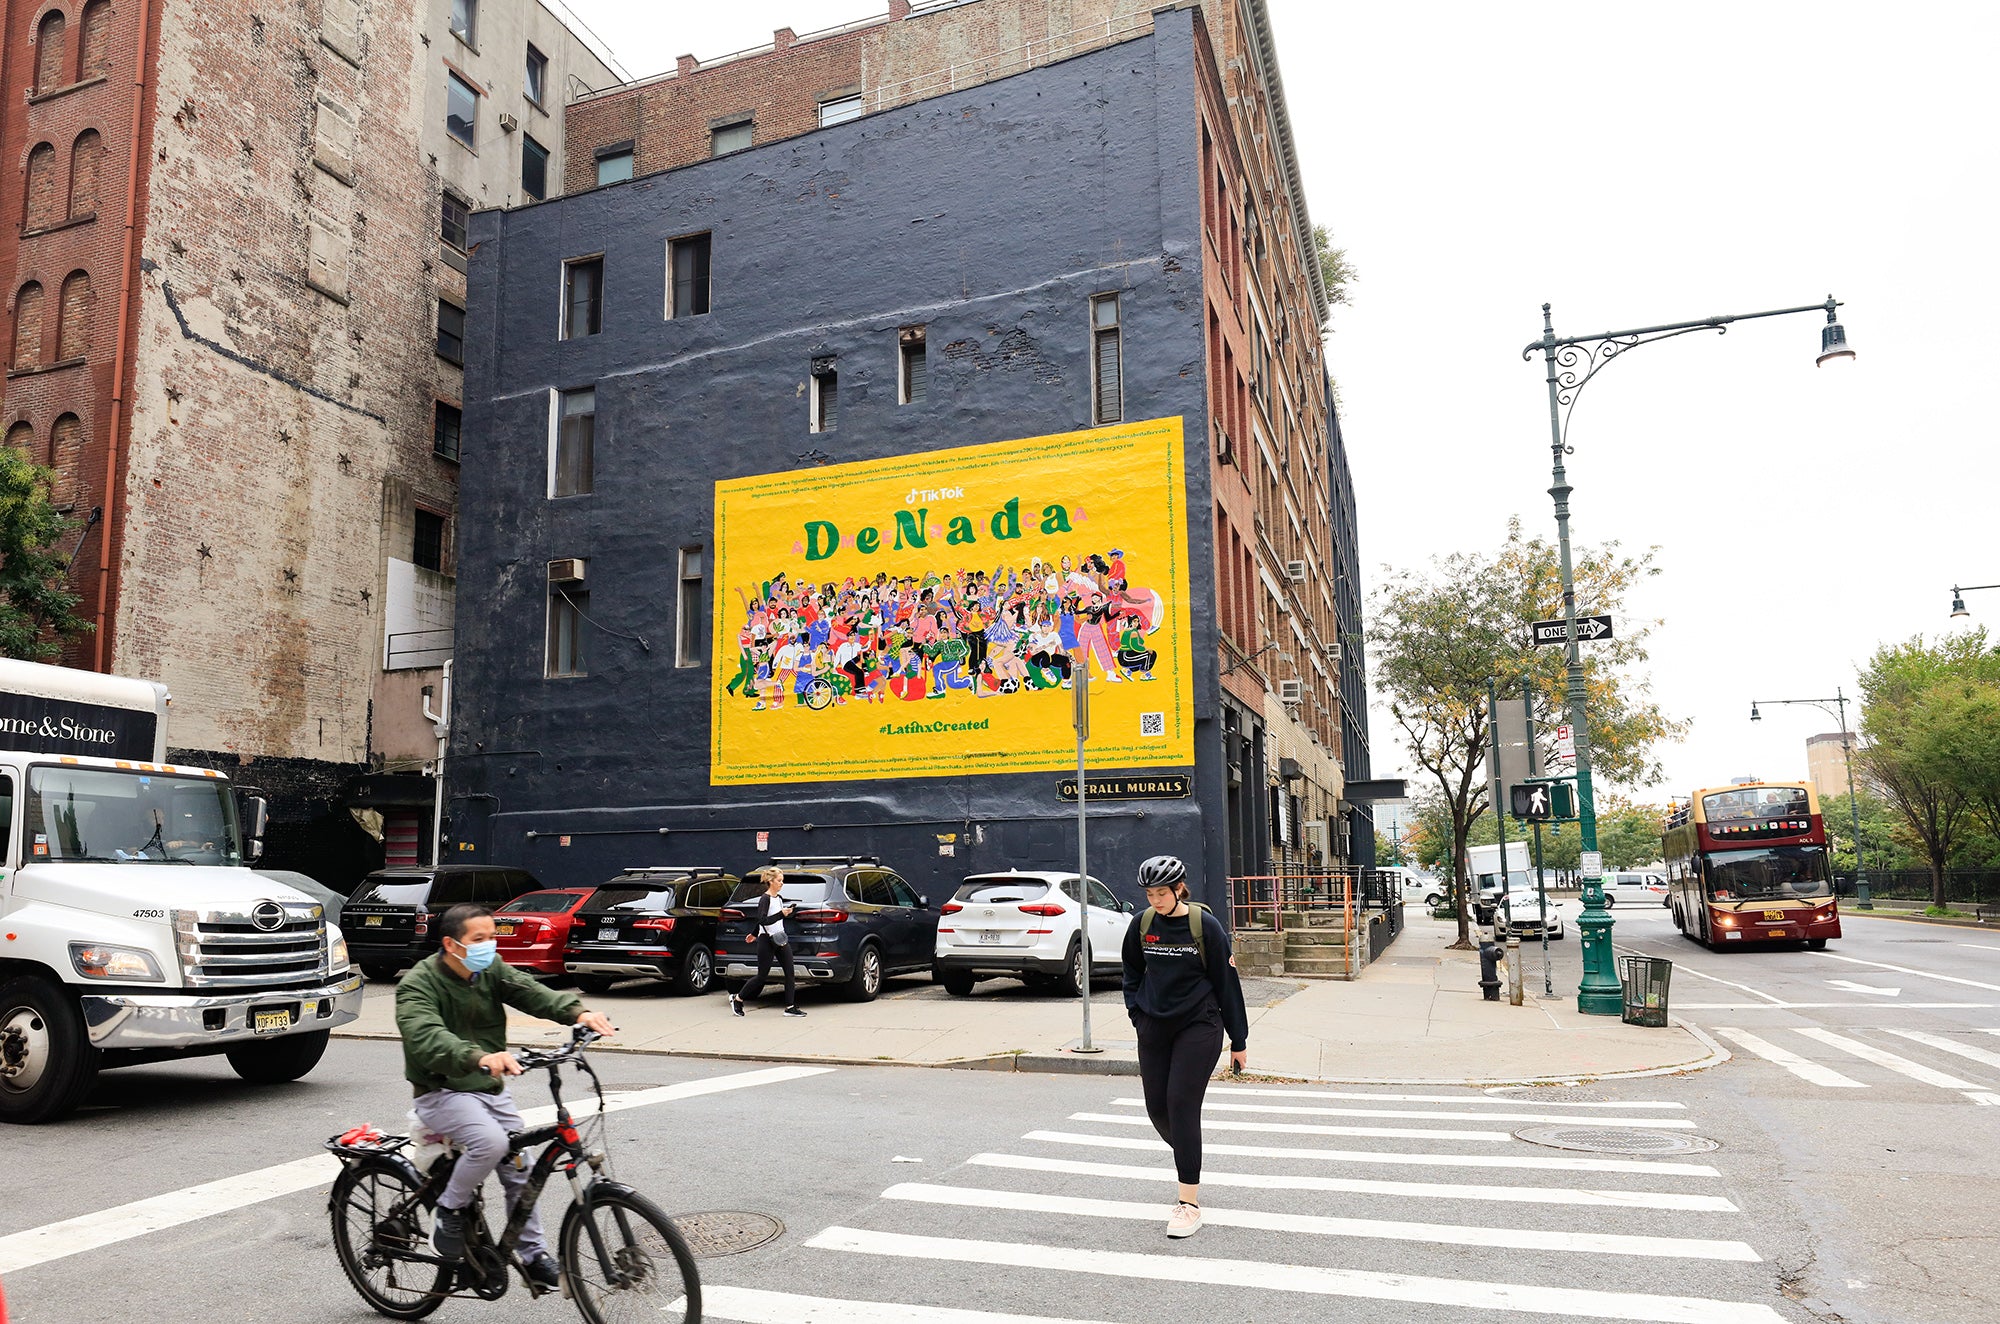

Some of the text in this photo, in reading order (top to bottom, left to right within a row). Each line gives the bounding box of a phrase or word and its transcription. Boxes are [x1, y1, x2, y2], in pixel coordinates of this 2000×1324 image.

[919, 486, 965, 503] TikTok
[1544, 623, 1600, 637] ONE WAY
[0, 715, 116, 744] me&Stone
[1127, 781, 1183, 793] MURALS
[132, 909, 165, 918] 47503
